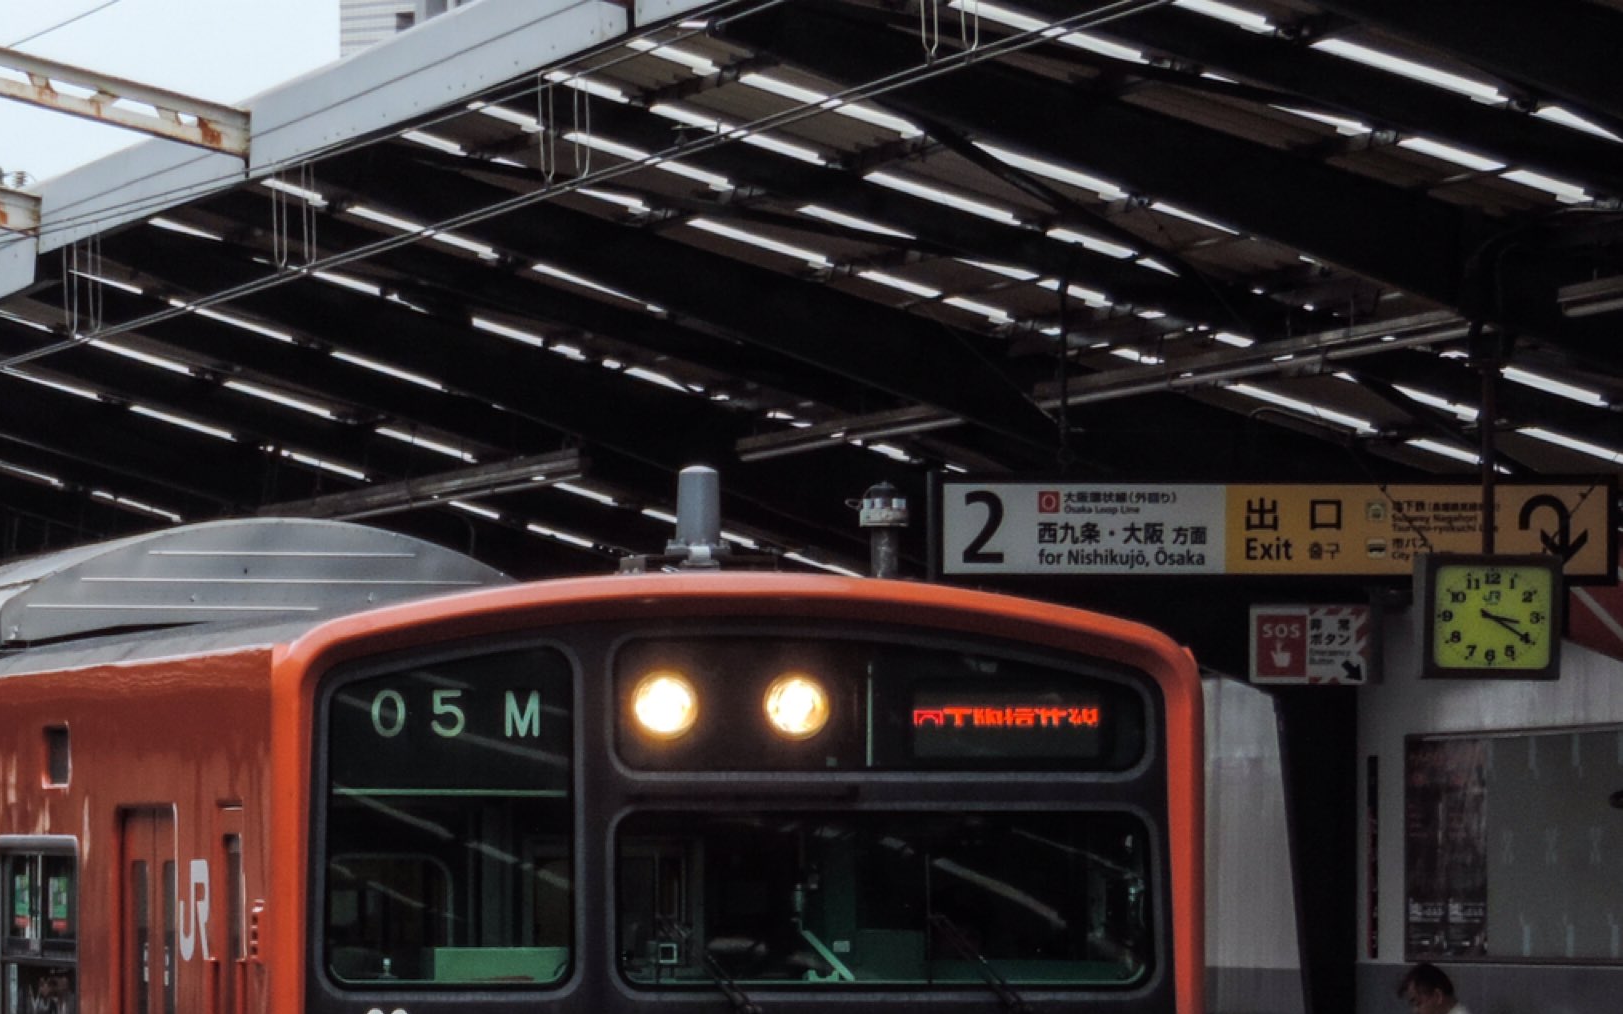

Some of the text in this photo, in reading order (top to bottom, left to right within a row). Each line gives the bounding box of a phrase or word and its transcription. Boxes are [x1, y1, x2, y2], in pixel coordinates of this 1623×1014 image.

[1245, 497, 1342, 531] 出口
[962, 490, 1005, 564] 2
[1172, 526, 1207, 545] 方面
[1245, 537, 1293, 560] Exit
[1038, 548, 1063, 566] for
[1155, 547, 1206, 566] Ōsaka
[1485, 573, 1501, 584] 12
[1451, 591, 1466, 603] 10
[1522, 590, 1533, 603] 2
[1442, 610, 1453, 622] 9
[1529, 612, 1540, 624] 3
[1262, 623, 1301, 639] SOS
[1450, 630, 1462, 643] 8
[1466, 645, 1477, 657] 7
[1484, 649, 1496, 661] 6
[1504, 645, 1515, 657] 5
[179, 858, 211, 962] JR
